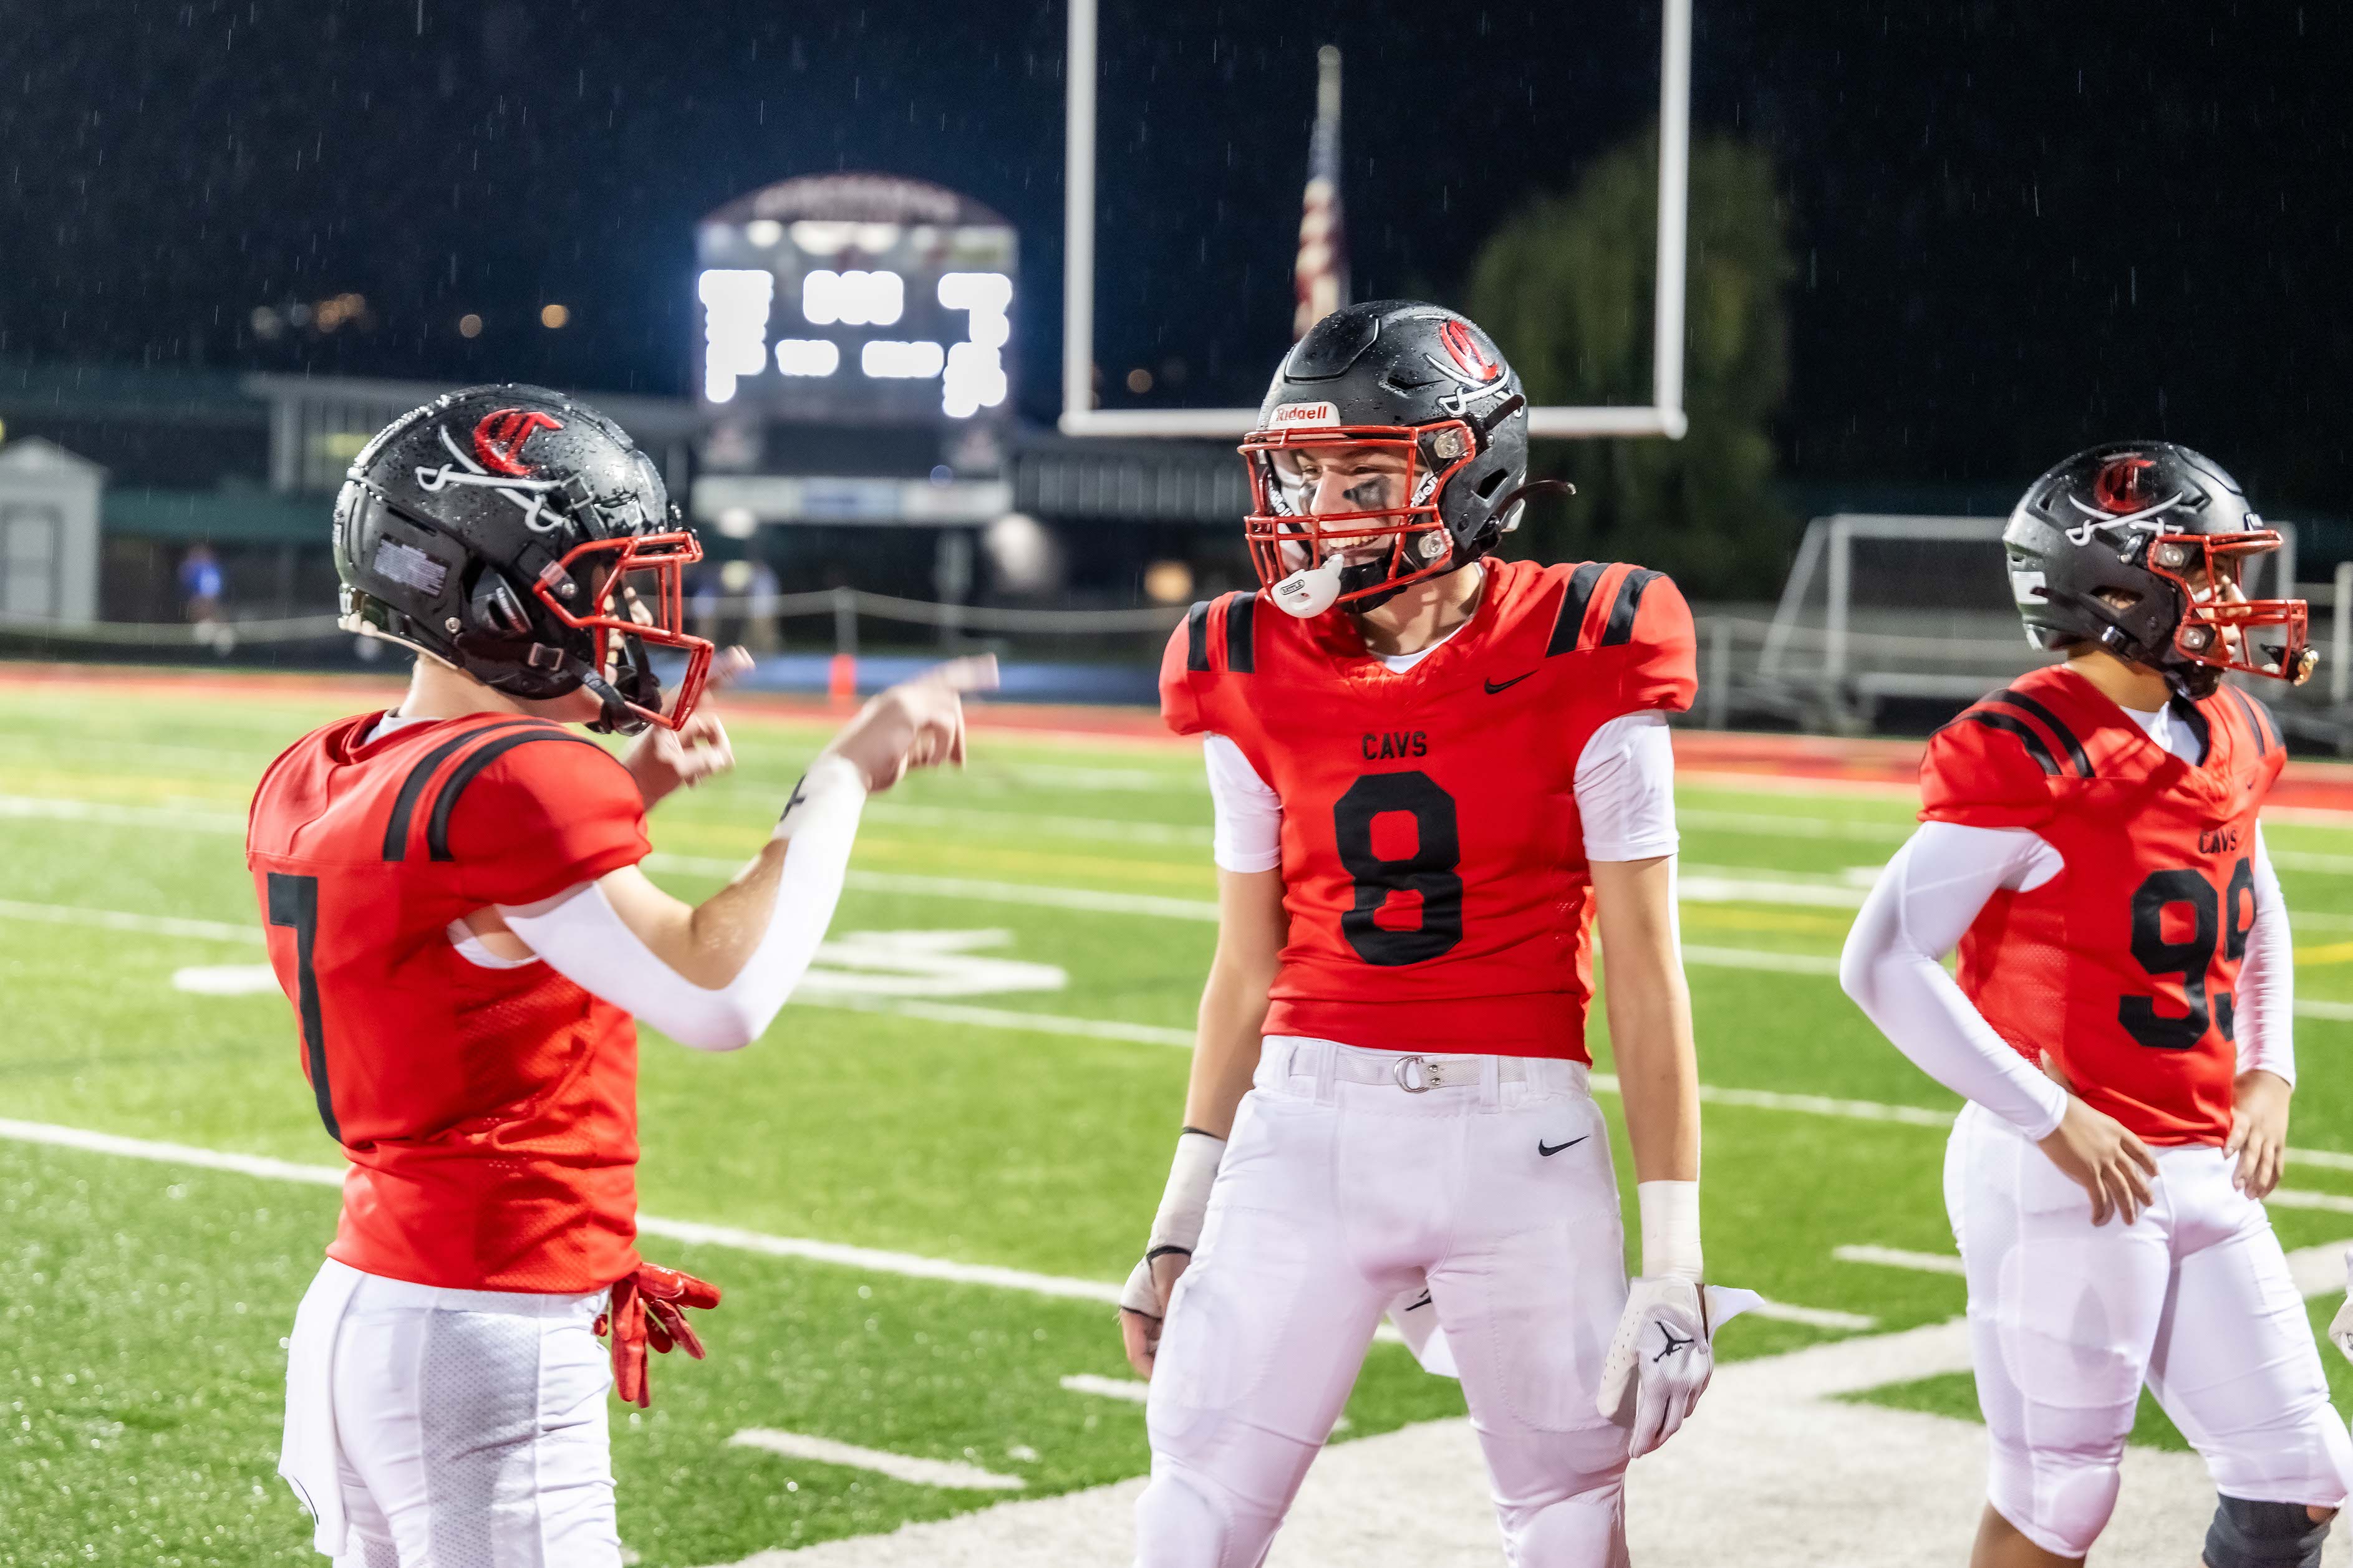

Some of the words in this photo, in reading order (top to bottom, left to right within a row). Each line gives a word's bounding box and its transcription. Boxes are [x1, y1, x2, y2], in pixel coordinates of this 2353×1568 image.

[1362, 731, 1428, 760] CAVS
[2198, 829, 2238, 854] CAVS
[1333, 771, 1464, 966] 8
[2118, 856, 2256, 1049] 99
[267, 872, 344, 1143] 7
